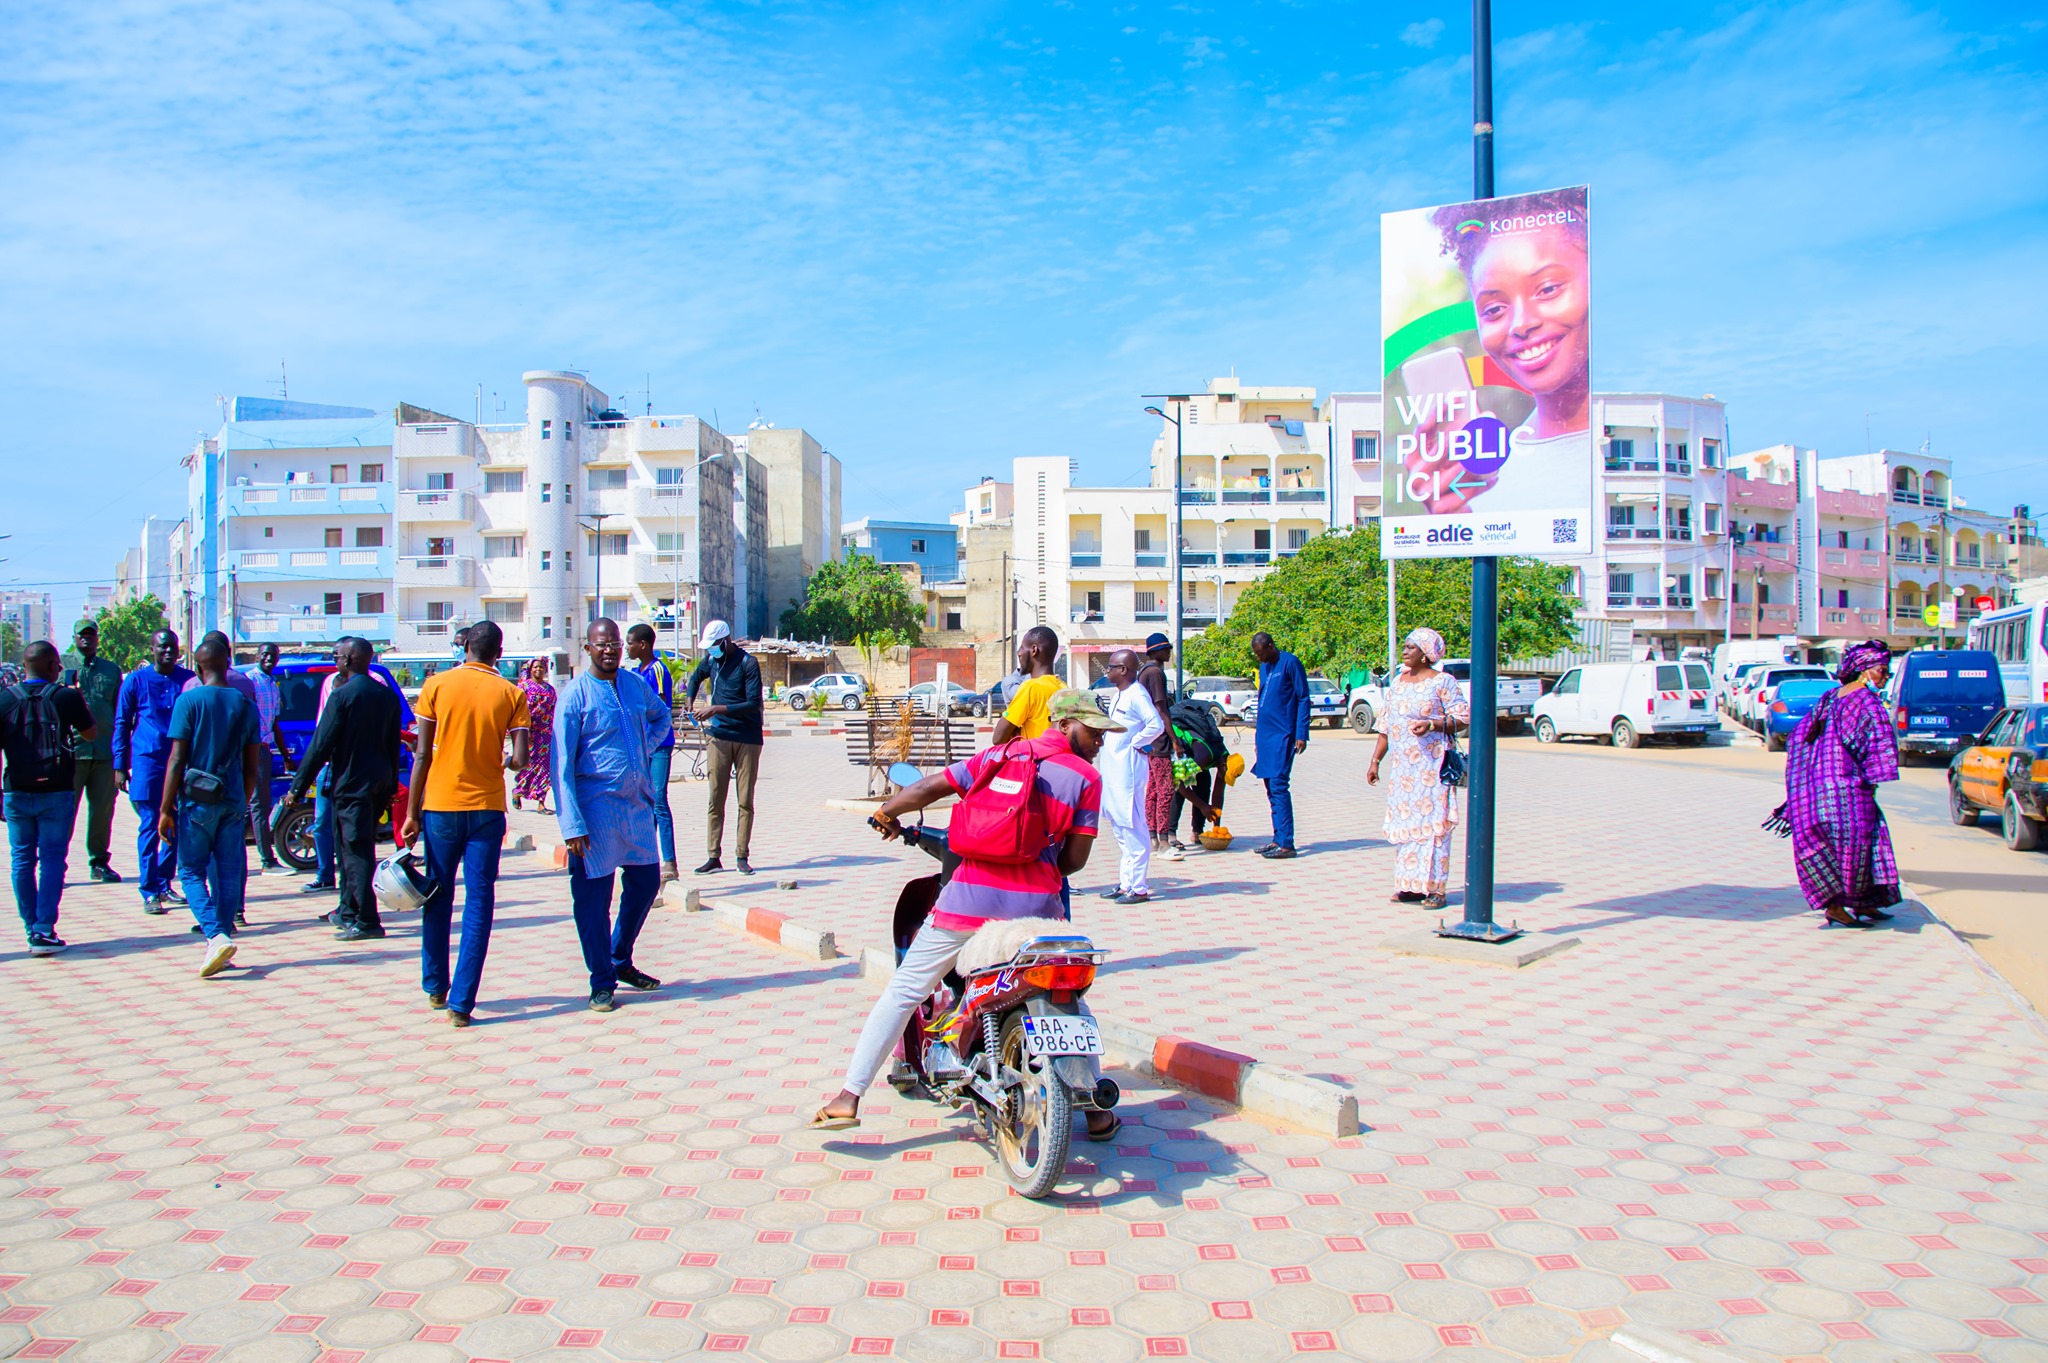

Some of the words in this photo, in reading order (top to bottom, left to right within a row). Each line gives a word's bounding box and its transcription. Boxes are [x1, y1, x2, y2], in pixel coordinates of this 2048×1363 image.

[1394, 390, 1477, 426] WIFI
[1396, 425, 1536, 465] PUBLIC
[1396, 470, 1441, 503] ICI
[1426, 524, 1474, 543] adie
[1484, 522, 1511, 532] smart
